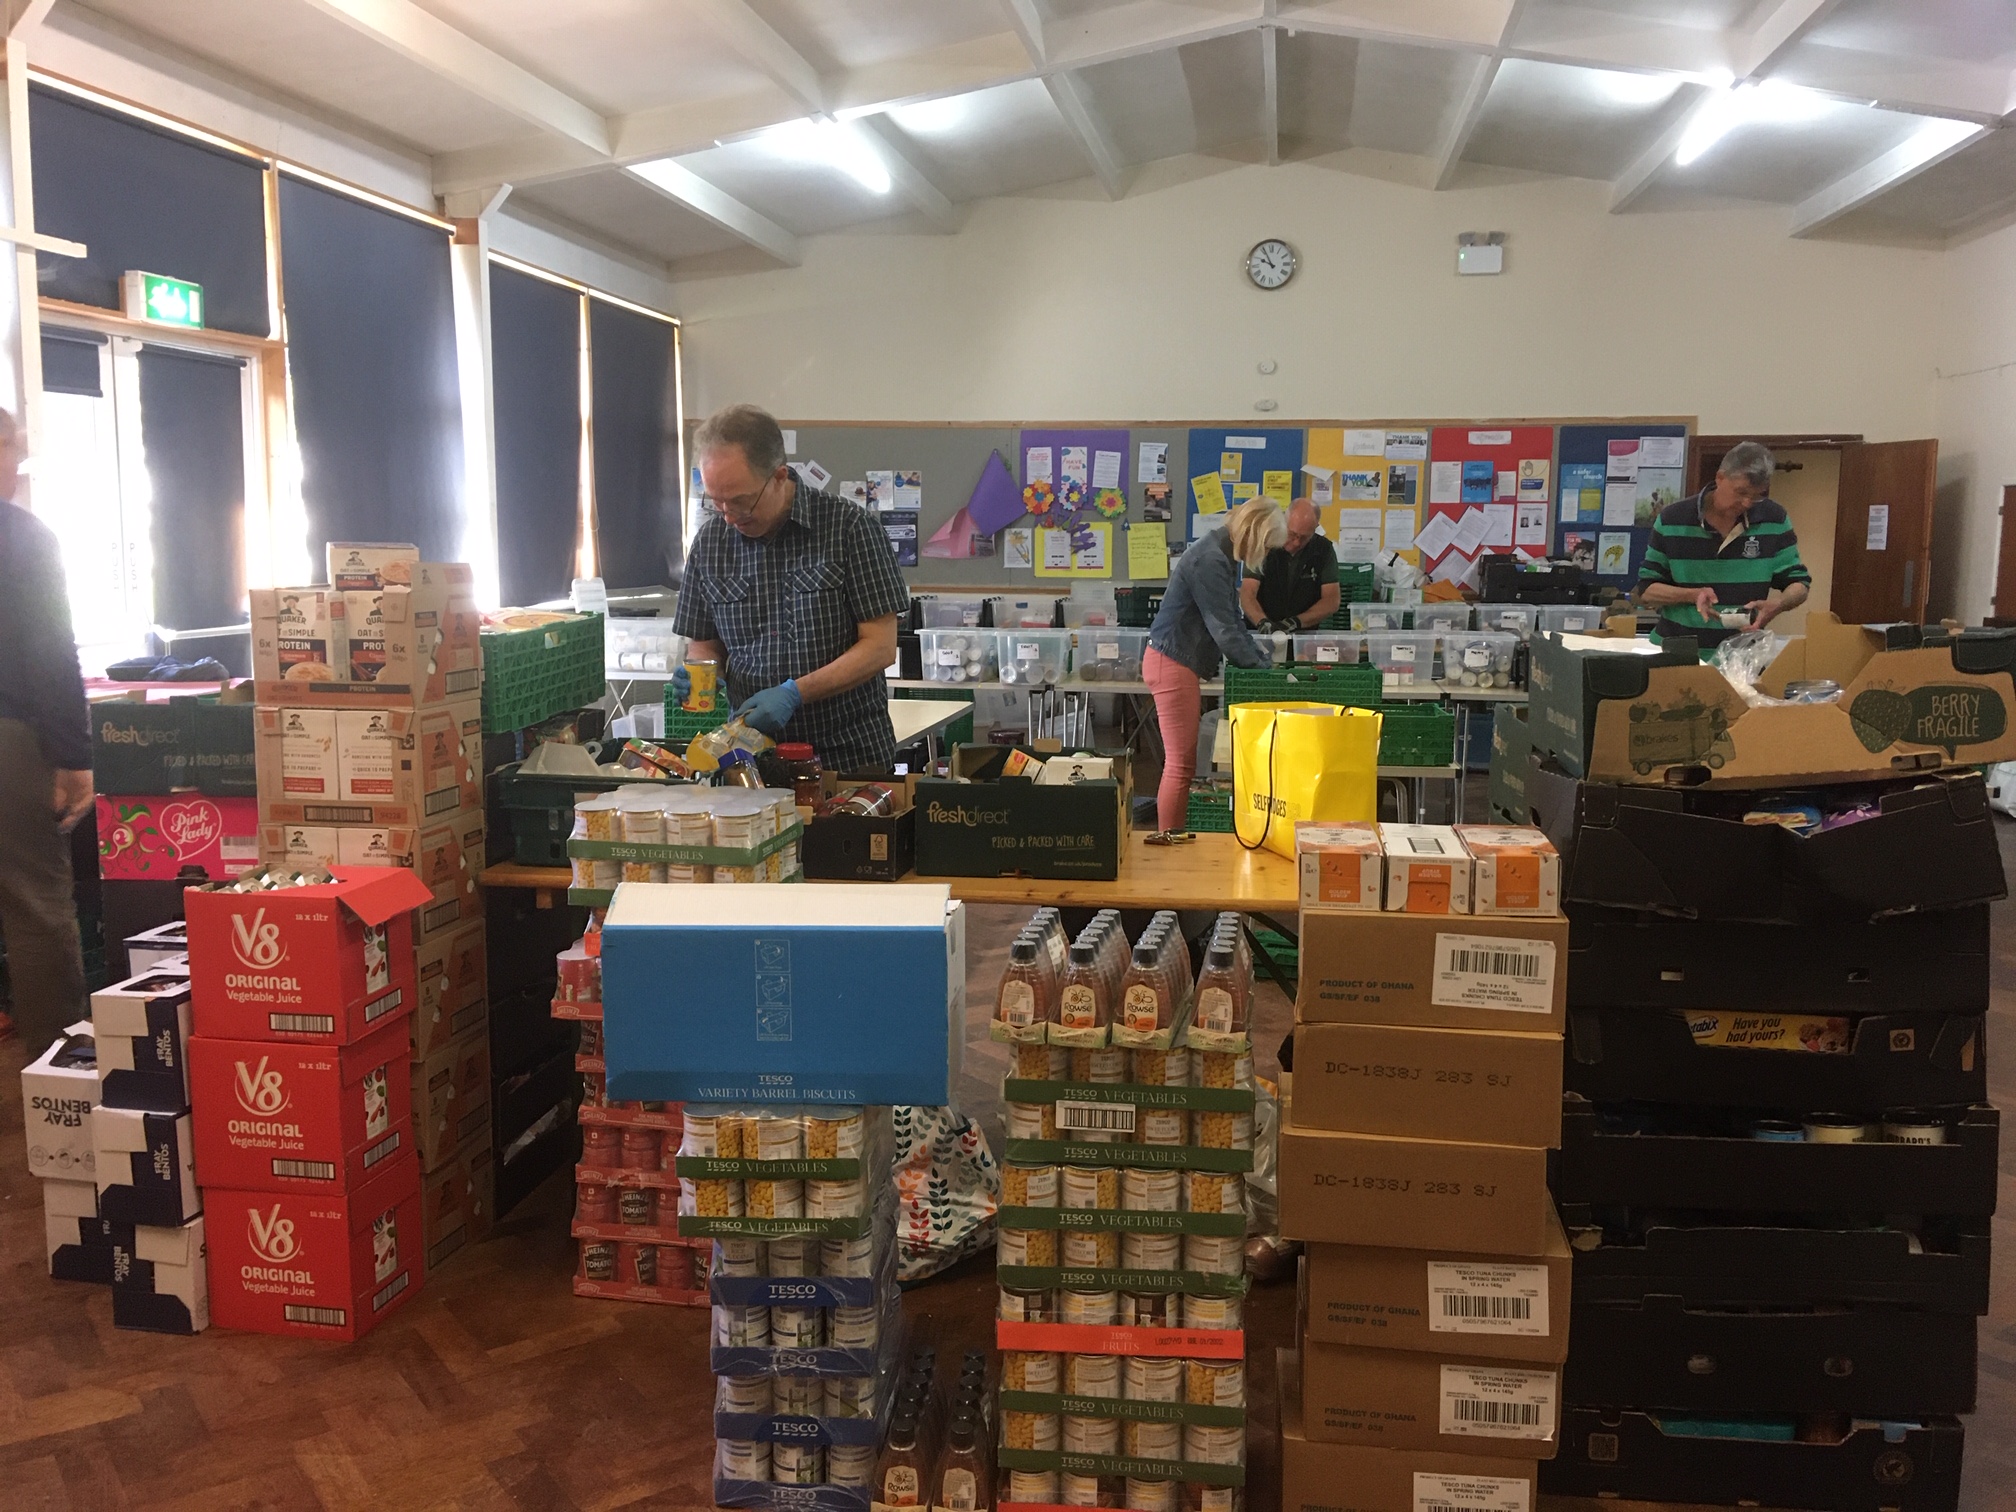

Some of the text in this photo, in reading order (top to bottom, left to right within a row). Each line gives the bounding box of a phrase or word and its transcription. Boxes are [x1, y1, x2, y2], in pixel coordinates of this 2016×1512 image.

[362, 640, 386, 651] PROT
[392, 644, 406, 656] 6x
[348, 685, 377, 693] PROTEIN
[1931, 693, 1980, 718] BERRY
[101, 721, 181, 747] freshdirect
[1916, 715, 1980, 739] FRAGILE
[1252, 792, 1287, 818] SELFDGES
[171, 805, 210, 832] Pink
[926, 801, 1009, 826] freshdirect
[176, 822, 214, 846] Lady
[991, 835, 1095, 848] PICKED & PACKED WITH CARE
[611, 846, 705, 861] TESCO VEGETABLES
[231, 907, 280, 965] V8
[224, 973, 302, 991] ORIGINAL
[1320, 979, 1415, 990] PRODUCT OF GHANA
[226, 988, 303, 1006] Vegetable Juice
[558, 1006, 579, 1016] HEINZ
[1064, 1003, 1092, 1014] Rowse
[1127, 1003, 1155, 1014] Rowse
[1732, 1017, 1781, 1031] Have you
[1726, 1028, 1786, 1043] had yours?
[156, 1035, 165, 1060] FRAY
[165, 1029, 173, 1067] BENTOS
[758, 1074, 794, 1085] TESCO
[1325, 1061, 1513, 1087] DC-1838J 283 SJ
[234, 1055, 283, 1112] V8
[698, 1087, 857, 1100] VARIETY BARREL BISCUITS
[1063, 1089, 1187, 1105] TESCO VEGETABLES
[32, 1096, 91, 1114] BENTOS
[43, 1111, 82, 1127] FRAY
[585, 1112, 606, 1120] HEINZ
[227, 1119, 304, 1139] ORIGINAL
[228, 1134, 305, 1151] Vegetable Juice
[153, 1149, 162, 1174] FRAY
[162, 1142, 171, 1181] BENTOS
[1064, 1147, 1187, 1162] TESCO VEGETABLES
[706, 1160, 828, 1173] TESCO VEGETABLES
[1313, 1174, 1497, 1198] DC-1838J 283 SJ
[623, 1193, 649, 1201] HEINZ
[622, 1205, 648, 1214] TOMATO
[709, 1221, 829, 1233] TESCO VEGETABLES
[1059, 1213, 1183, 1228] TESCO VEGETABLES
[246, 1202, 296, 1259] V8
[588, 1247, 614, 1255] HEINZ
[113, 1245, 122, 1283] BENTOS
[121, 1251, 130, 1277] FRAY
[586, 1260, 611, 1268] TOMATO
[241, 1264, 316, 1285] ORIGINAL
[1061, 1272, 1184, 1287] TESCO VEGETABLES
[241, 1279, 317, 1297] Vegetable Juice
[768, 1284, 817, 1295] TESCO
[1327, 1301, 1421, 1316] PRODUCT OF GHANA
[1102, 1341, 1140, 1352] FRUITS
[769, 1353, 817, 1365] TESCO
[1062, 1400, 1185, 1419] TESCO VEGETABLES
[1324, 1406, 1417, 1422] PRODUCT OF GHANA
[772, 1421, 819, 1433] TESCO
[1061, 1457, 1184, 1476] TESCO VEGETABLES
[887, 1483, 915, 1492] Rowse
[770, 1490, 817, 1501] TESCO
